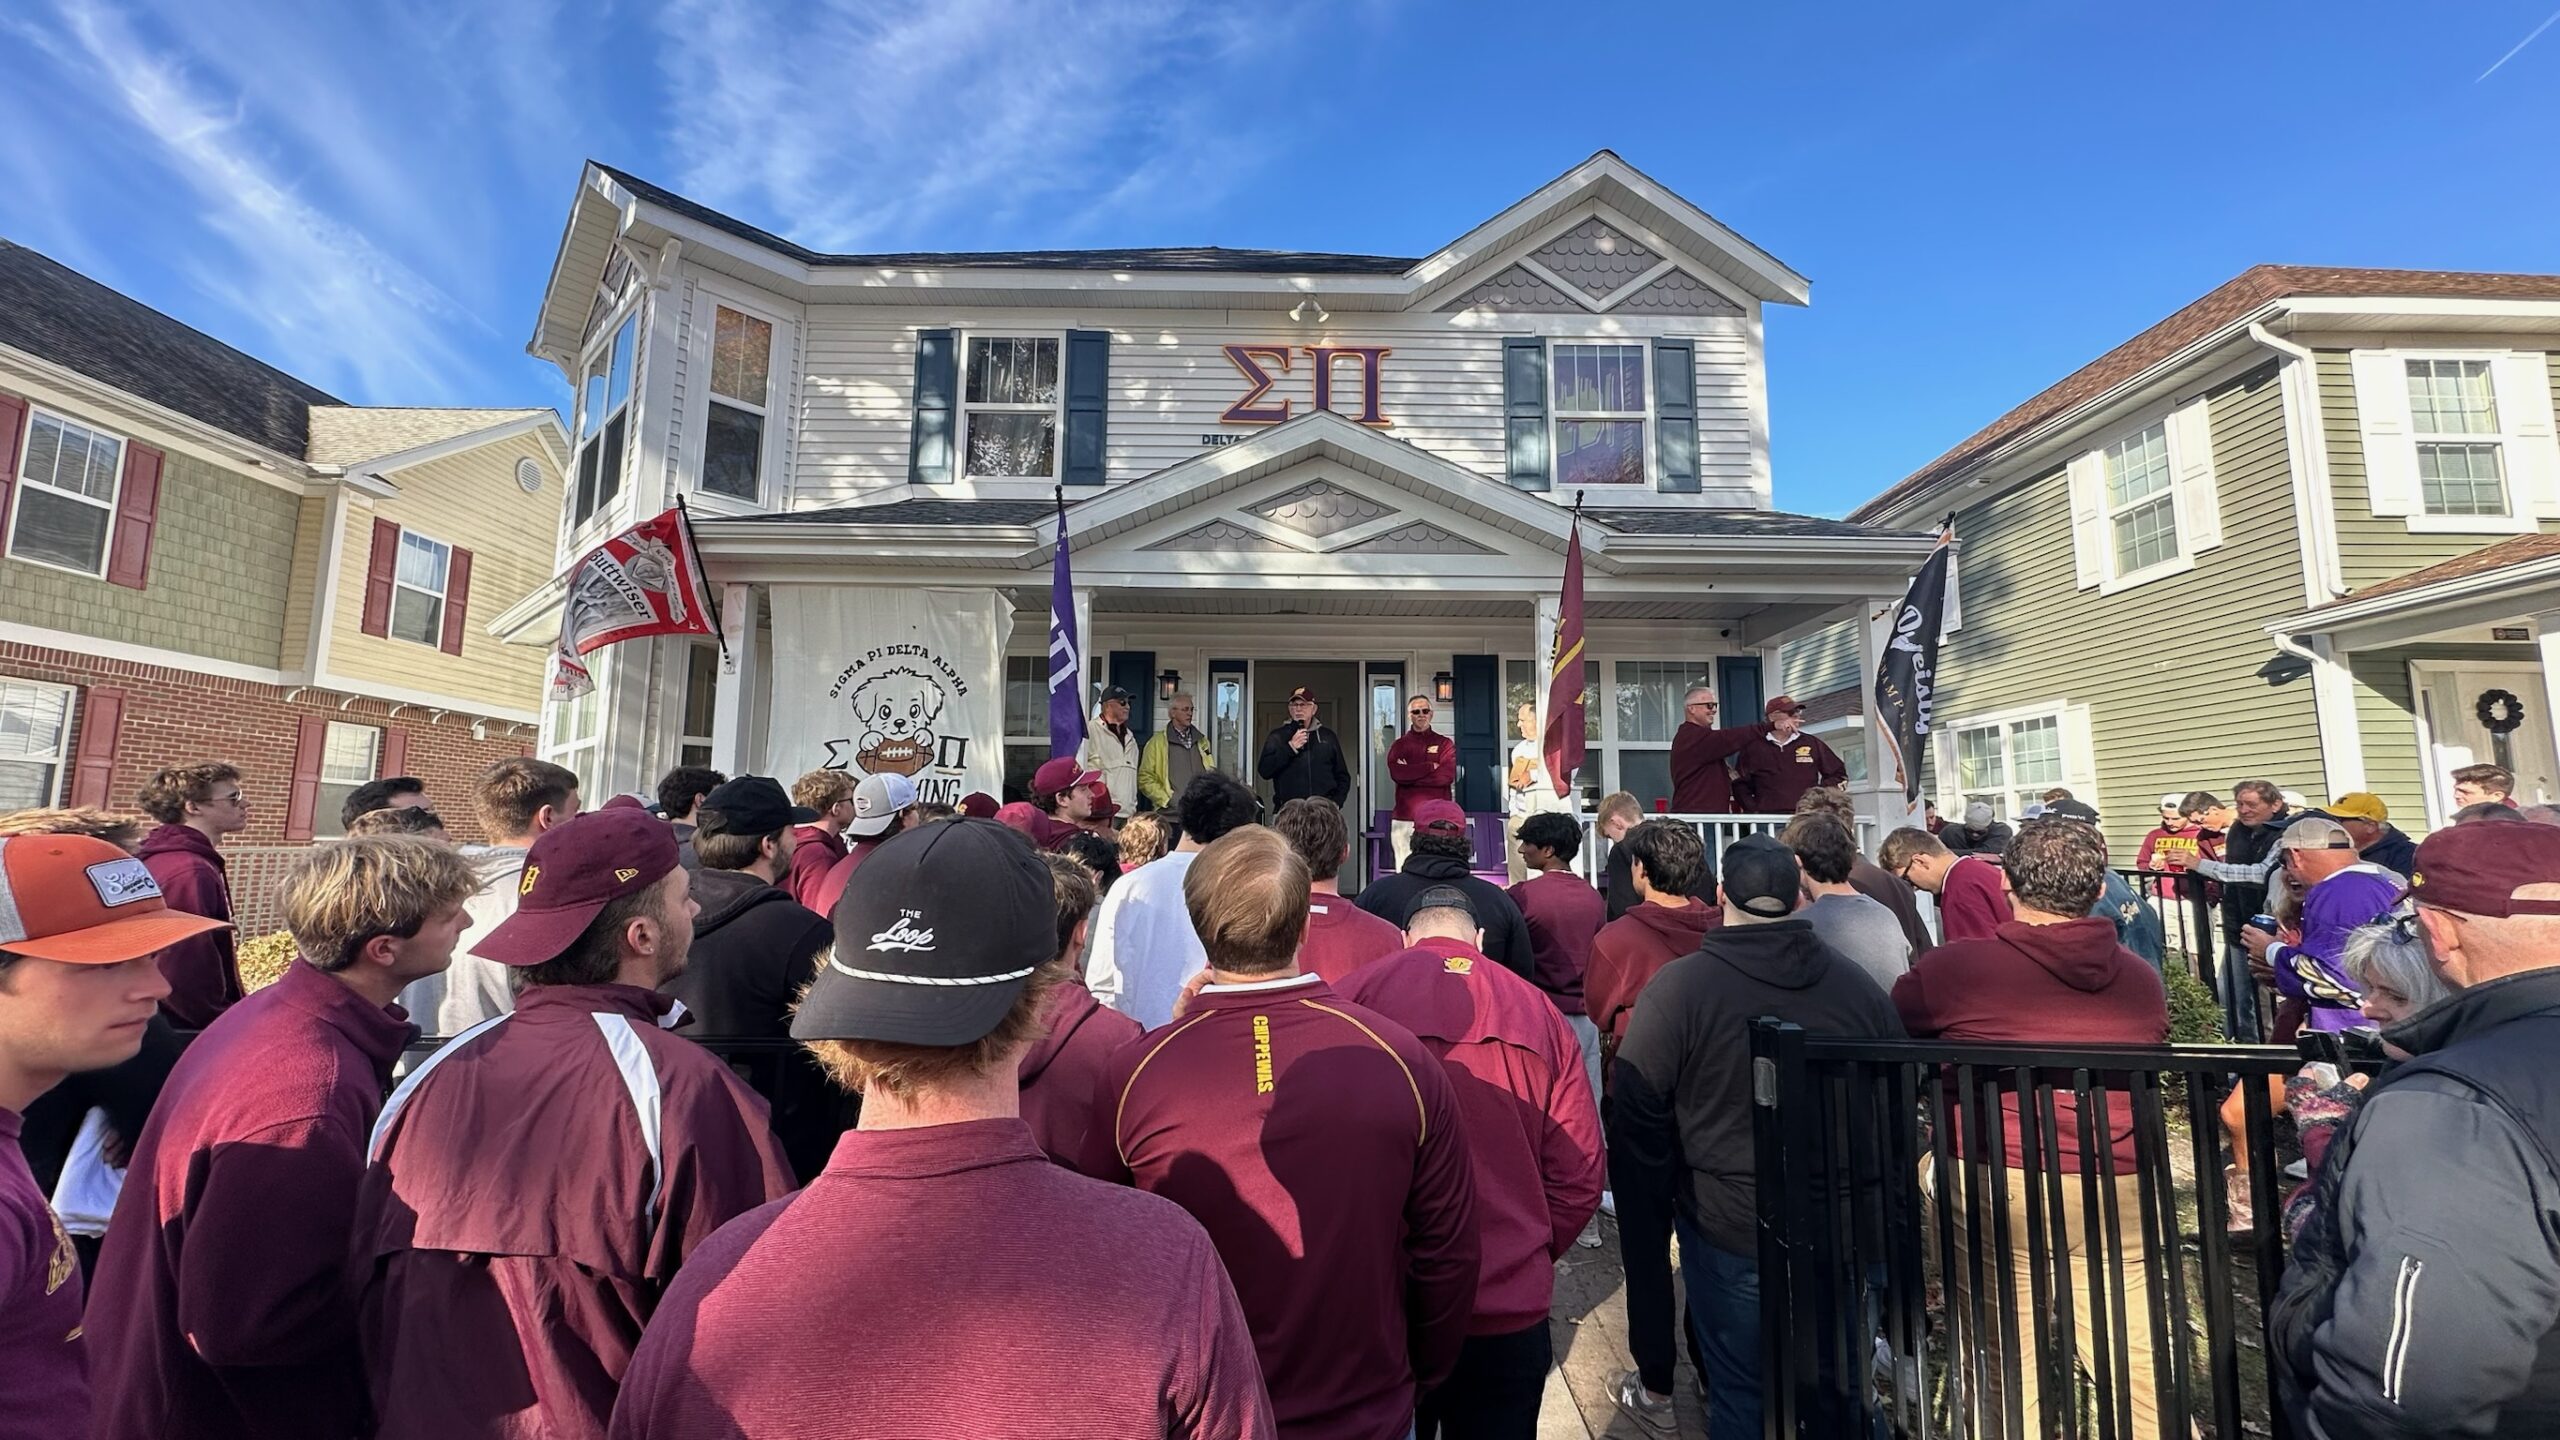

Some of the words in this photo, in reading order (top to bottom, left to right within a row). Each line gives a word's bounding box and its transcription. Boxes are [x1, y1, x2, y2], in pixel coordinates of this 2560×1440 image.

[1202, 434, 1241, 445] DELTA
[590, 549, 651, 619] Buttwiser
[829, 659, 866, 699] SIGMA
[866, 647, 883, 662] PI
[886, 644, 929, 660] DELTA
[932, 655, 968, 697] ALPHA
[2155, 837, 2198, 850] CENTRAL
[899, 908, 922, 919] THE
[871, 917, 934, 953] Loop
[1253, 1015, 1274, 1094] CHIPPEWAS
